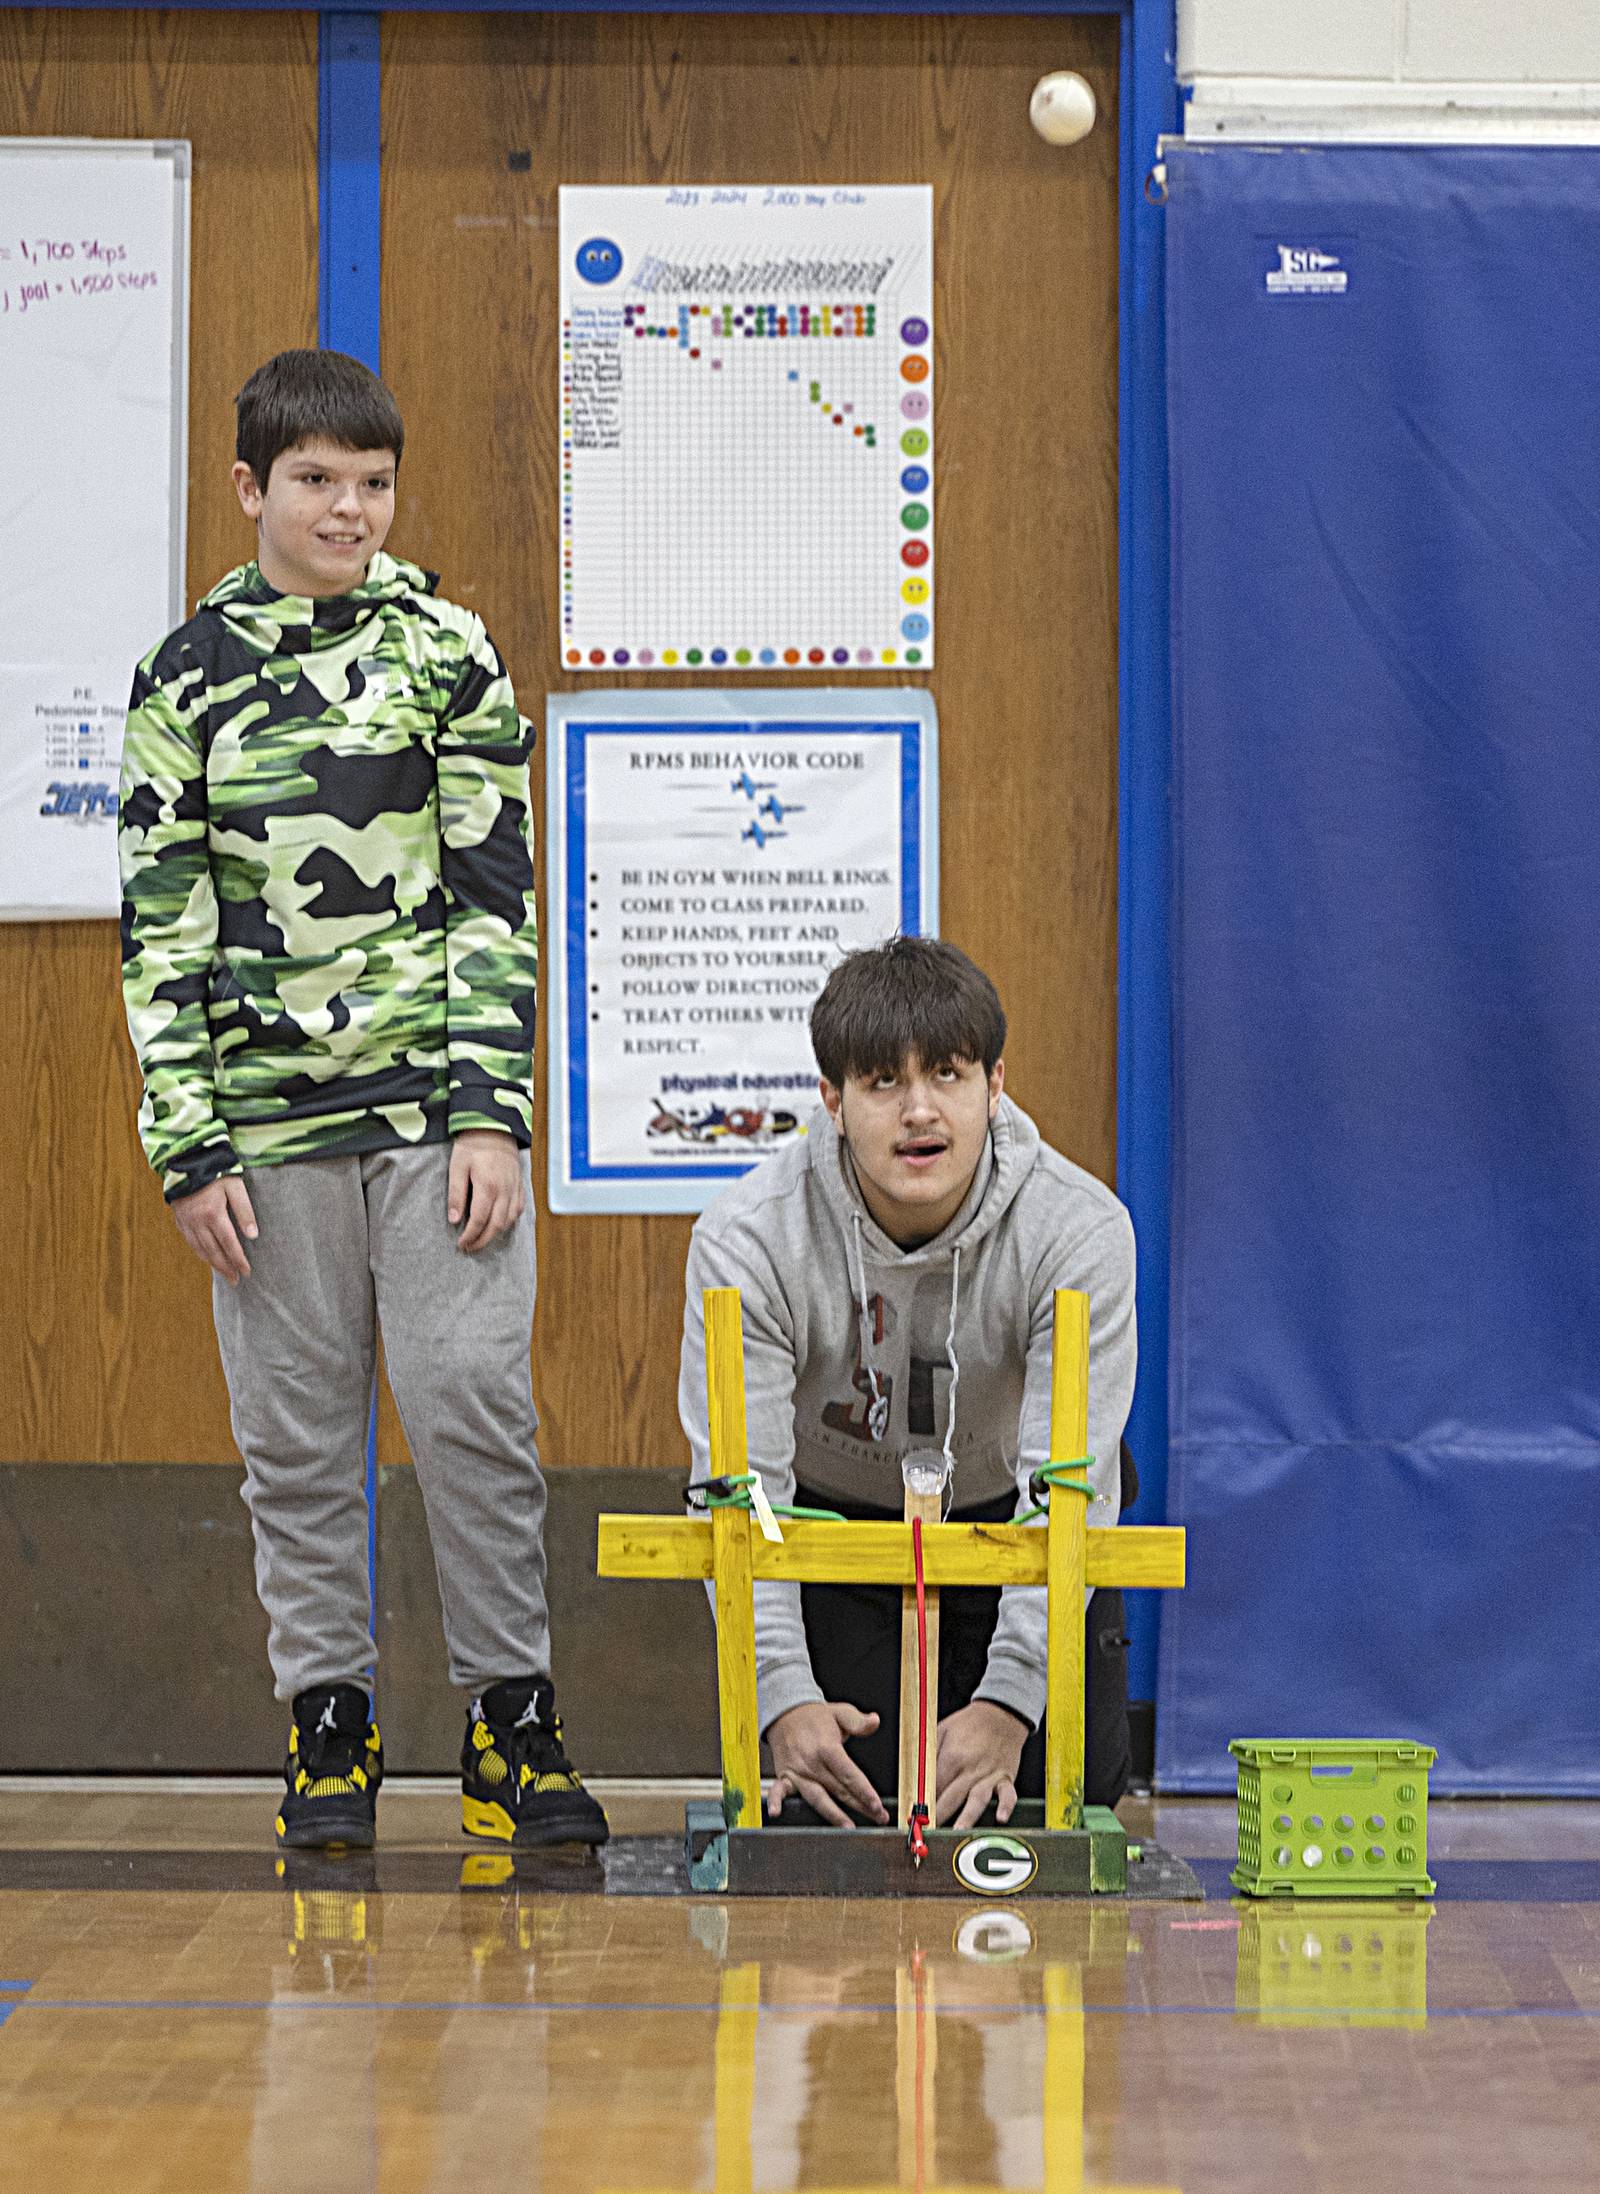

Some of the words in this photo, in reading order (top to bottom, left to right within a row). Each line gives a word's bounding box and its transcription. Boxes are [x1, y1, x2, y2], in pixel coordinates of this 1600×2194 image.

[691, 752, 799, 770] BEHAVIOR
[806, 752, 865, 770] CODE
[621, 869, 642, 886] BE
[648, 869, 668, 886] IN
[673, 869, 715, 886] GYM
[722, 869, 780, 886] WHEN
[786, 869, 828, 886] BELL
[621, 898, 675, 914] COME
[680, 898, 706, 914] TO
[711, 898, 763, 914] CLASS
[769, 898, 870, 914] PREPARED.
[622, 925, 668, 941] KEEP
[673, 925, 743, 943] HANDS,
[749, 925, 791, 941] FEET
[797, 925, 839, 941] AND
[621, 951, 697, 970] OBJECTS
[703, 951, 729, 967] TO
[622, 979, 700, 996] FOLLOW
[623, 1006, 684, 1023] TREAT
[689, 1006, 764, 1023] OTHERS
[768, 1006, 811, 1022] WIT
[623, 1038, 705, 1055] RESPECT.
[661, 1072, 738, 1092] physical
[958, 1834, 1033, 1891] G
